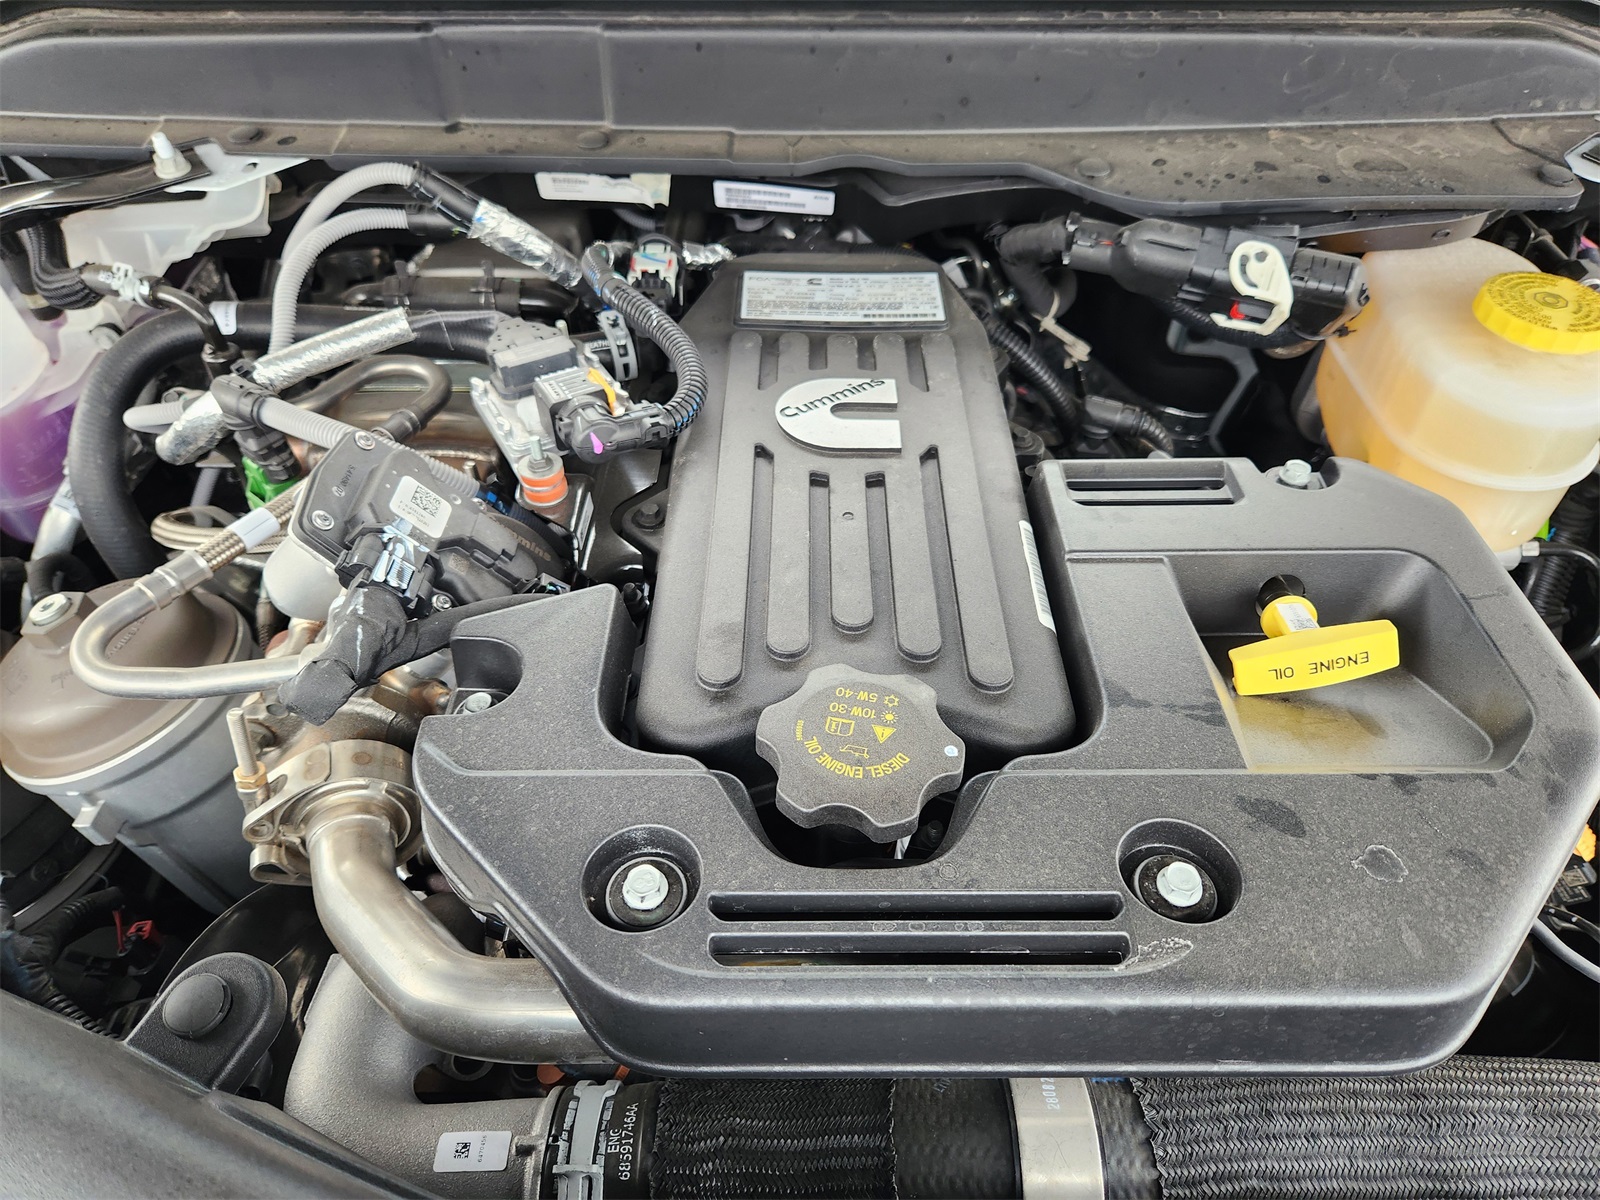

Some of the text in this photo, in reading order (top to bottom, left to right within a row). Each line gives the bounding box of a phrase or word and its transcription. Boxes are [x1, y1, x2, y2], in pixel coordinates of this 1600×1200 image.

[779, 378, 886, 418] Cummins
[1268, 651, 1369, 680] ENGINE OIL
[836, 687, 878, 703] 5W-40
[829, 702, 876, 719] 10W-30
[804, 736, 910, 778] DIESEL ENGINE OIL
[607, 1128, 622, 1153] ENG
